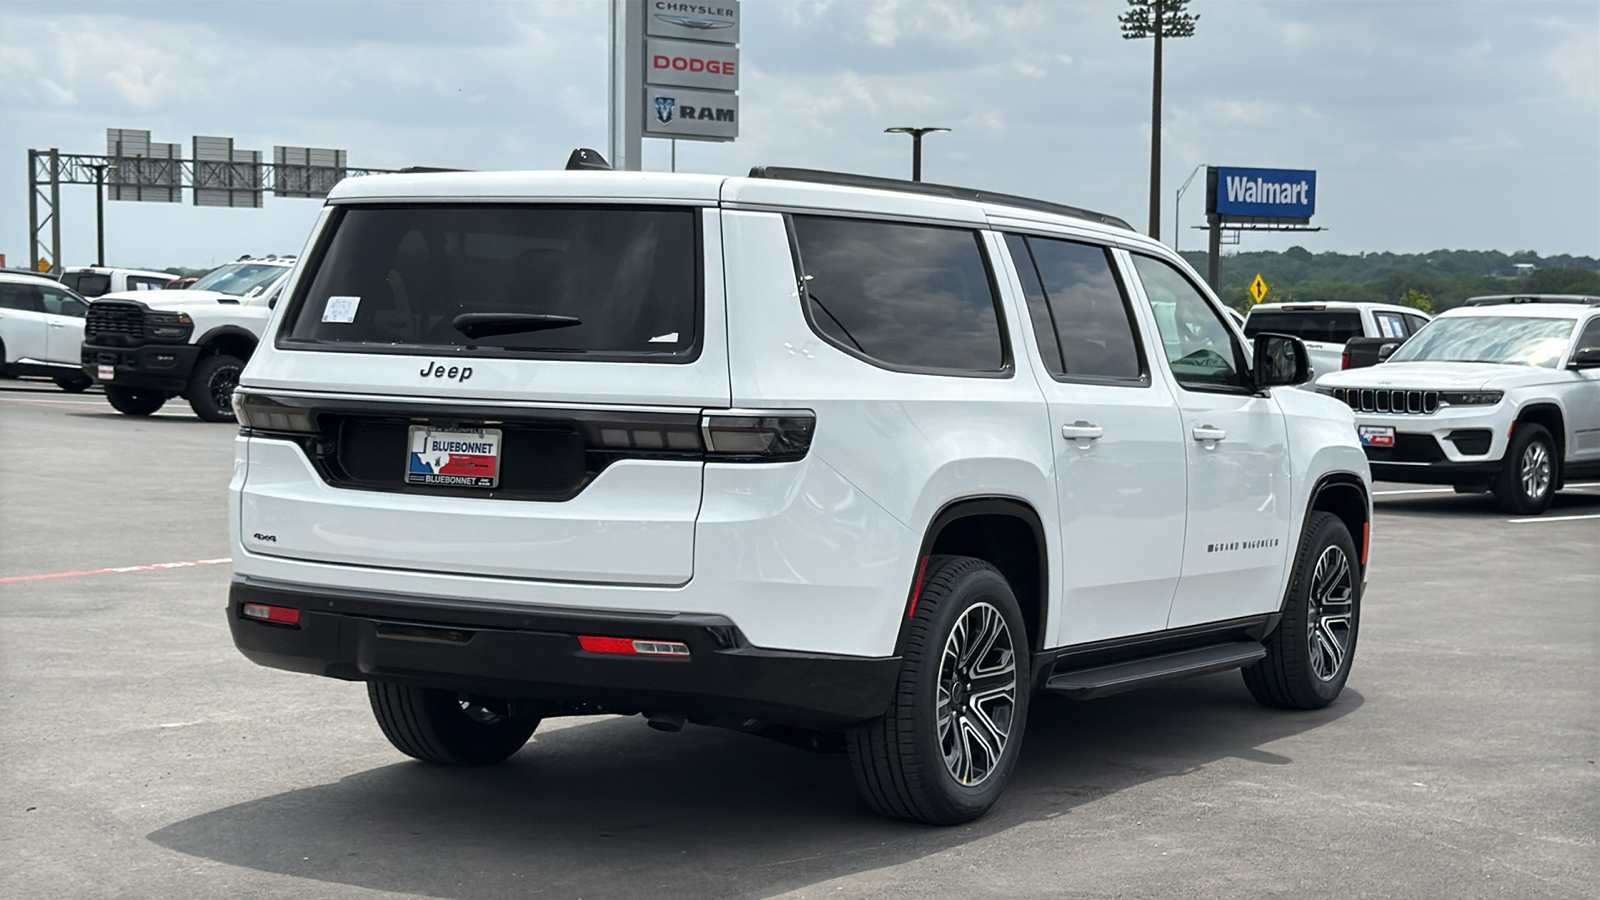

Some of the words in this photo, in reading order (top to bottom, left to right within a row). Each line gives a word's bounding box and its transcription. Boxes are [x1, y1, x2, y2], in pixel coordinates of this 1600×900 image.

[655, 1, 734, 17] CHRYSLER
[653, 55, 735, 75] DODGE
[679, 105, 735, 122] RAM
[1226, 175, 1309, 206] Walmart
[420, 361, 473, 383] Jeep
[432, 440, 494, 454] BLUEBONNET
[425, 474, 477, 485] BLUEBONNET
[1214, 542, 1239, 552] GRAND
[1242, 538, 1279, 549] WAGONEER
